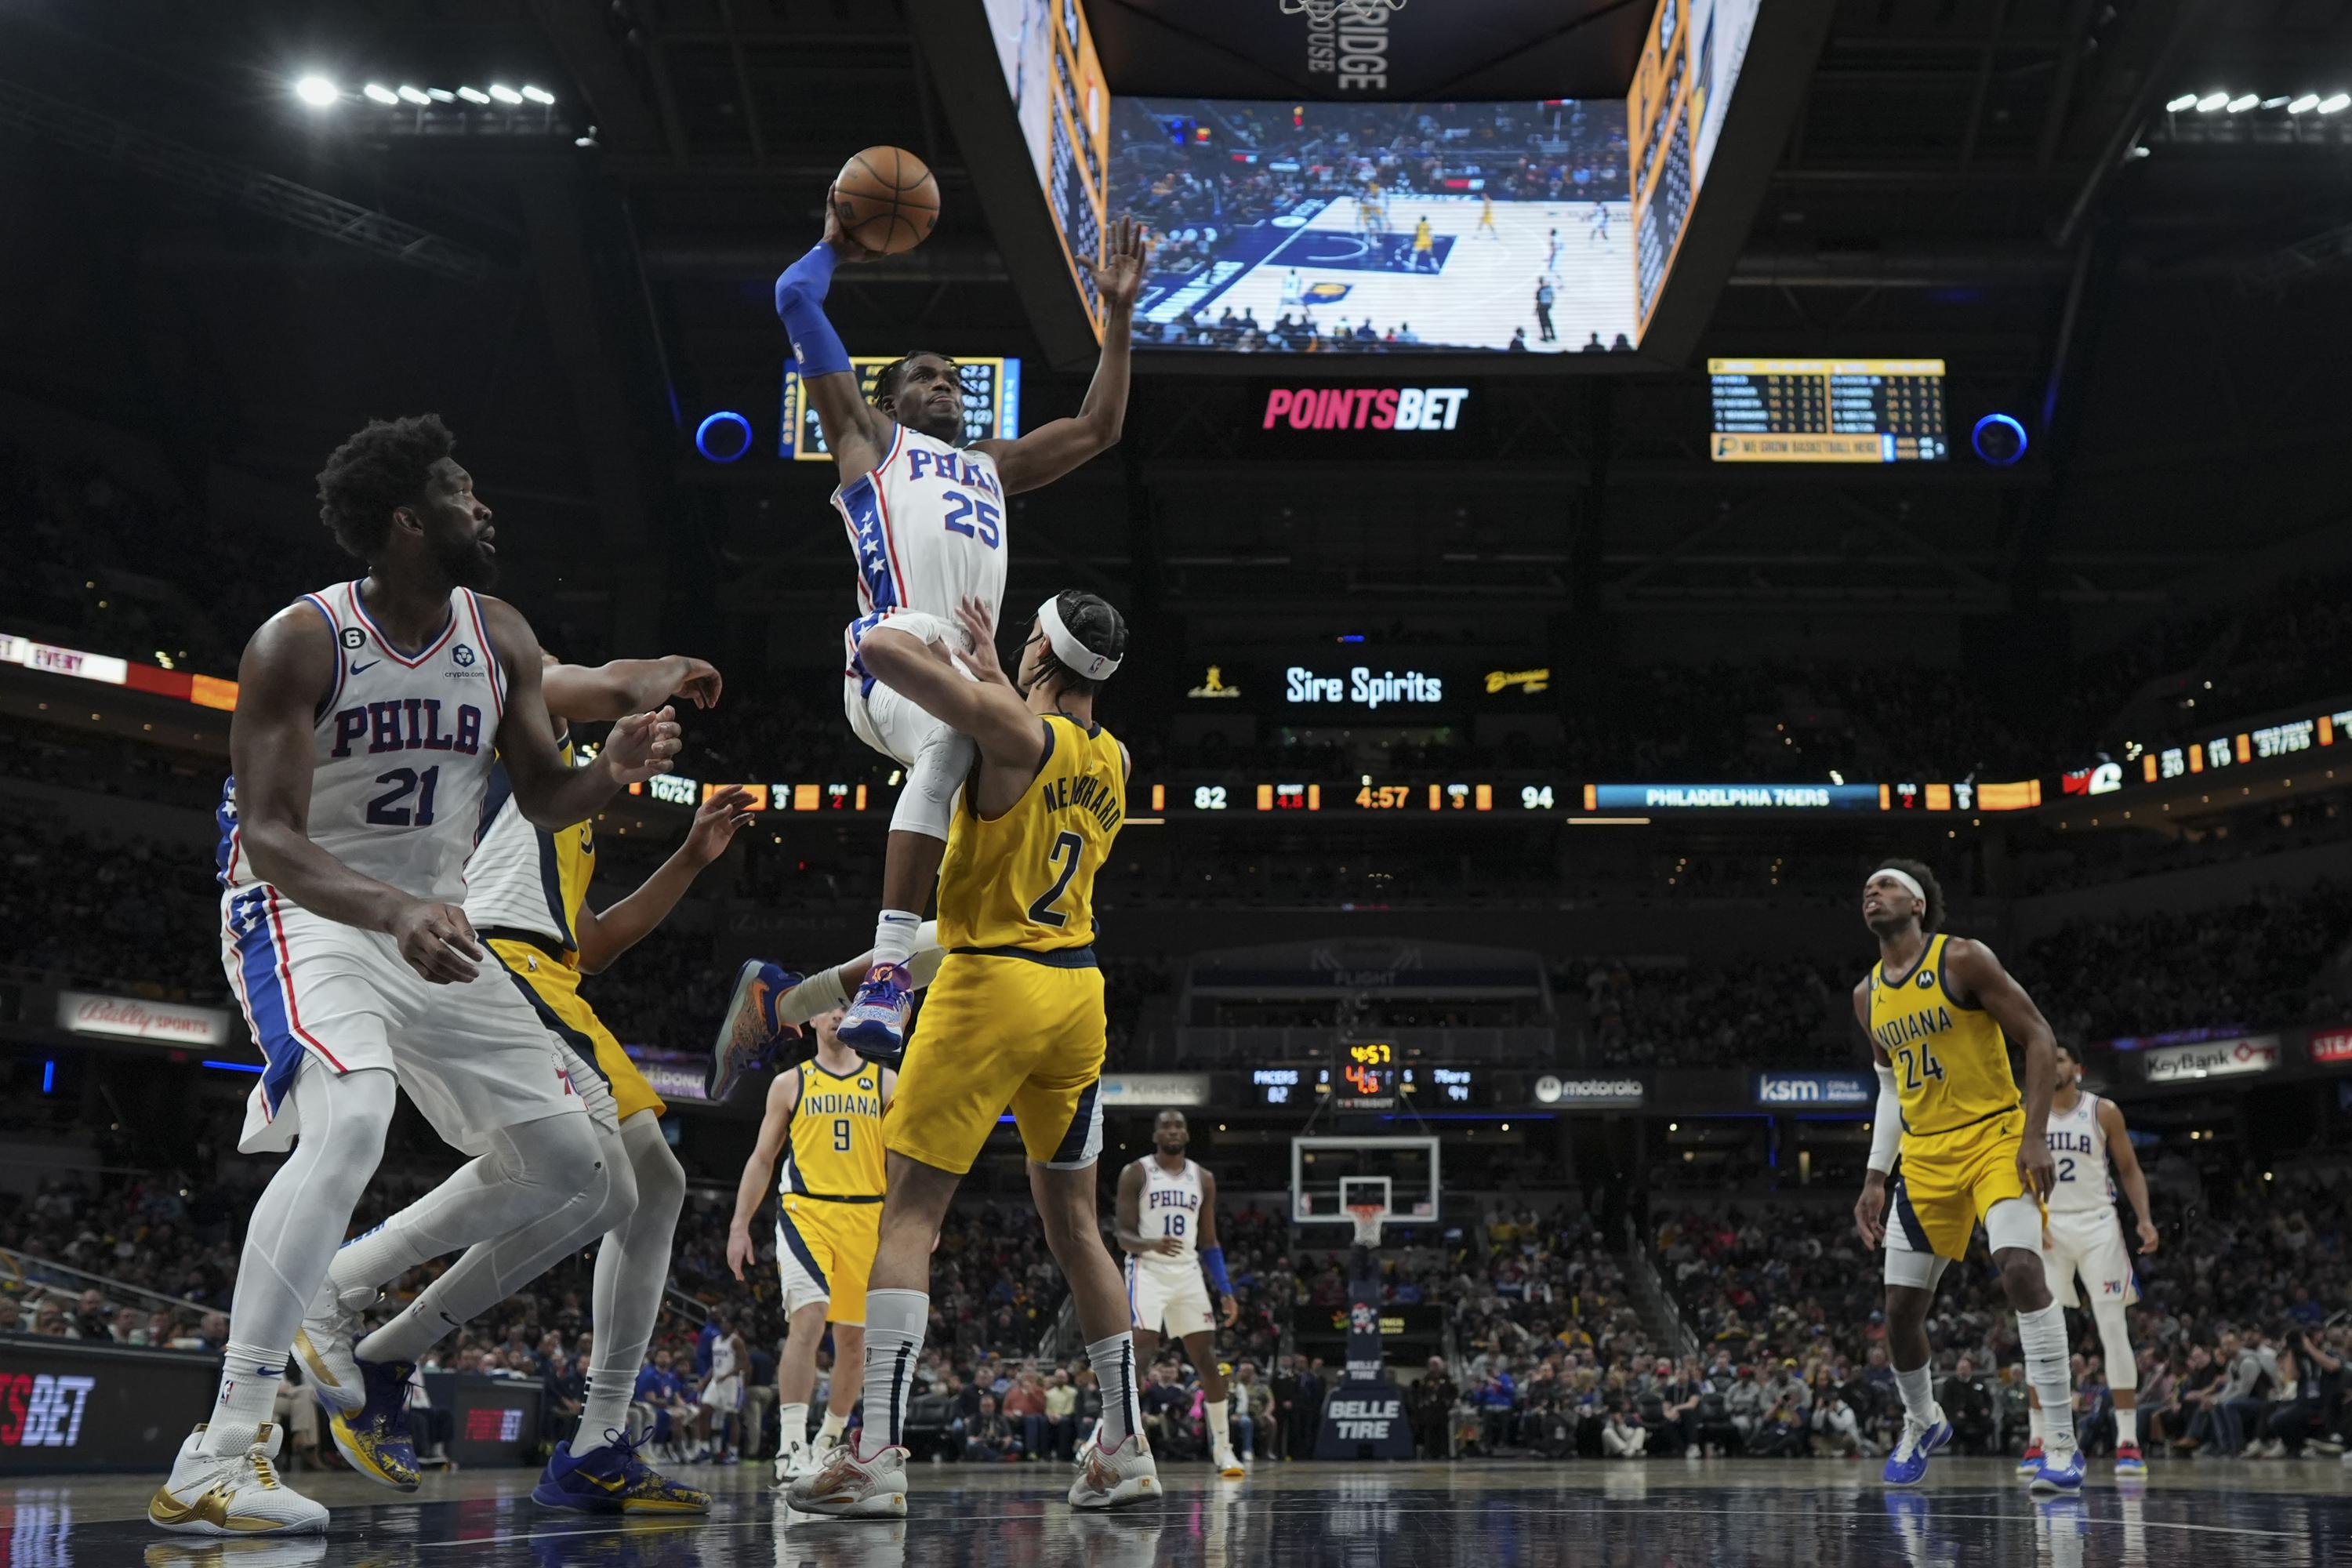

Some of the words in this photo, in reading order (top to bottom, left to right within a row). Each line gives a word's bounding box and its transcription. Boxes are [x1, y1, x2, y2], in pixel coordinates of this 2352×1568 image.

[1338, 0, 1389, 89] RIDGE
[1262, 388, 1469, 430] POINTSBET
[942, 489, 1000, 551] 25
[345, 630, 364, 647] 6
[445, 670, 485, 680] crypto.com
[1287, 666, 1343, 702] Sire
[1351, 666, 1443, 710] Spirits
[330, 699, 482, 758] PHILA
[365, 765, 440, 827] 21
[650, 781, 695, 806] 10/24
[833, 795, 845, 809] 2
[1194, 786, 1228, 810] 82
[1355, 786, 1410, 809] 4:57
[1451, 794, 1465, 809] 3
[1522, 786, 1554, 809] 94
[1646, 788, 1773, 807] PHILADELPHIA
[1774, 788, 1830, 807] 76ERS
[1902, 794, 1914, 809] 2
[1028, 829, 1084, 930] 2
[79, 995, 153, 1036] Bally
[156, 1015, 210, 1034] SPORTS
[1876, 1006, 1953, 1048] NDIANA
[1351, 1044, 1391, 1065] 4:57
[2147, 1049, 2230, 1075] KeyBank
[1898, 1044, 1943, 1089] 24
[1563, 1079, 1643, 1097] motorola
[1760, 1073, 1819, 1101] ksm
[804, 1094, 879, 1119] INDIANA
[833, 1119, 850, 1151] 9
[2046, 1132, 2092, 1155] HILA
[2058, 1158, 2076, 1182] 2
[1149, 1190, 1199, 1212] PHILA
[1163, 1214, 1185, 1236] 18
[2103, 1280, 2122, 1294] 76
[1345, 1360, 1382, 1370] BELLE
[1327, 1399, 1400, 1419] BELLE
[1335, 1421, 1390, 1439] TIRE
